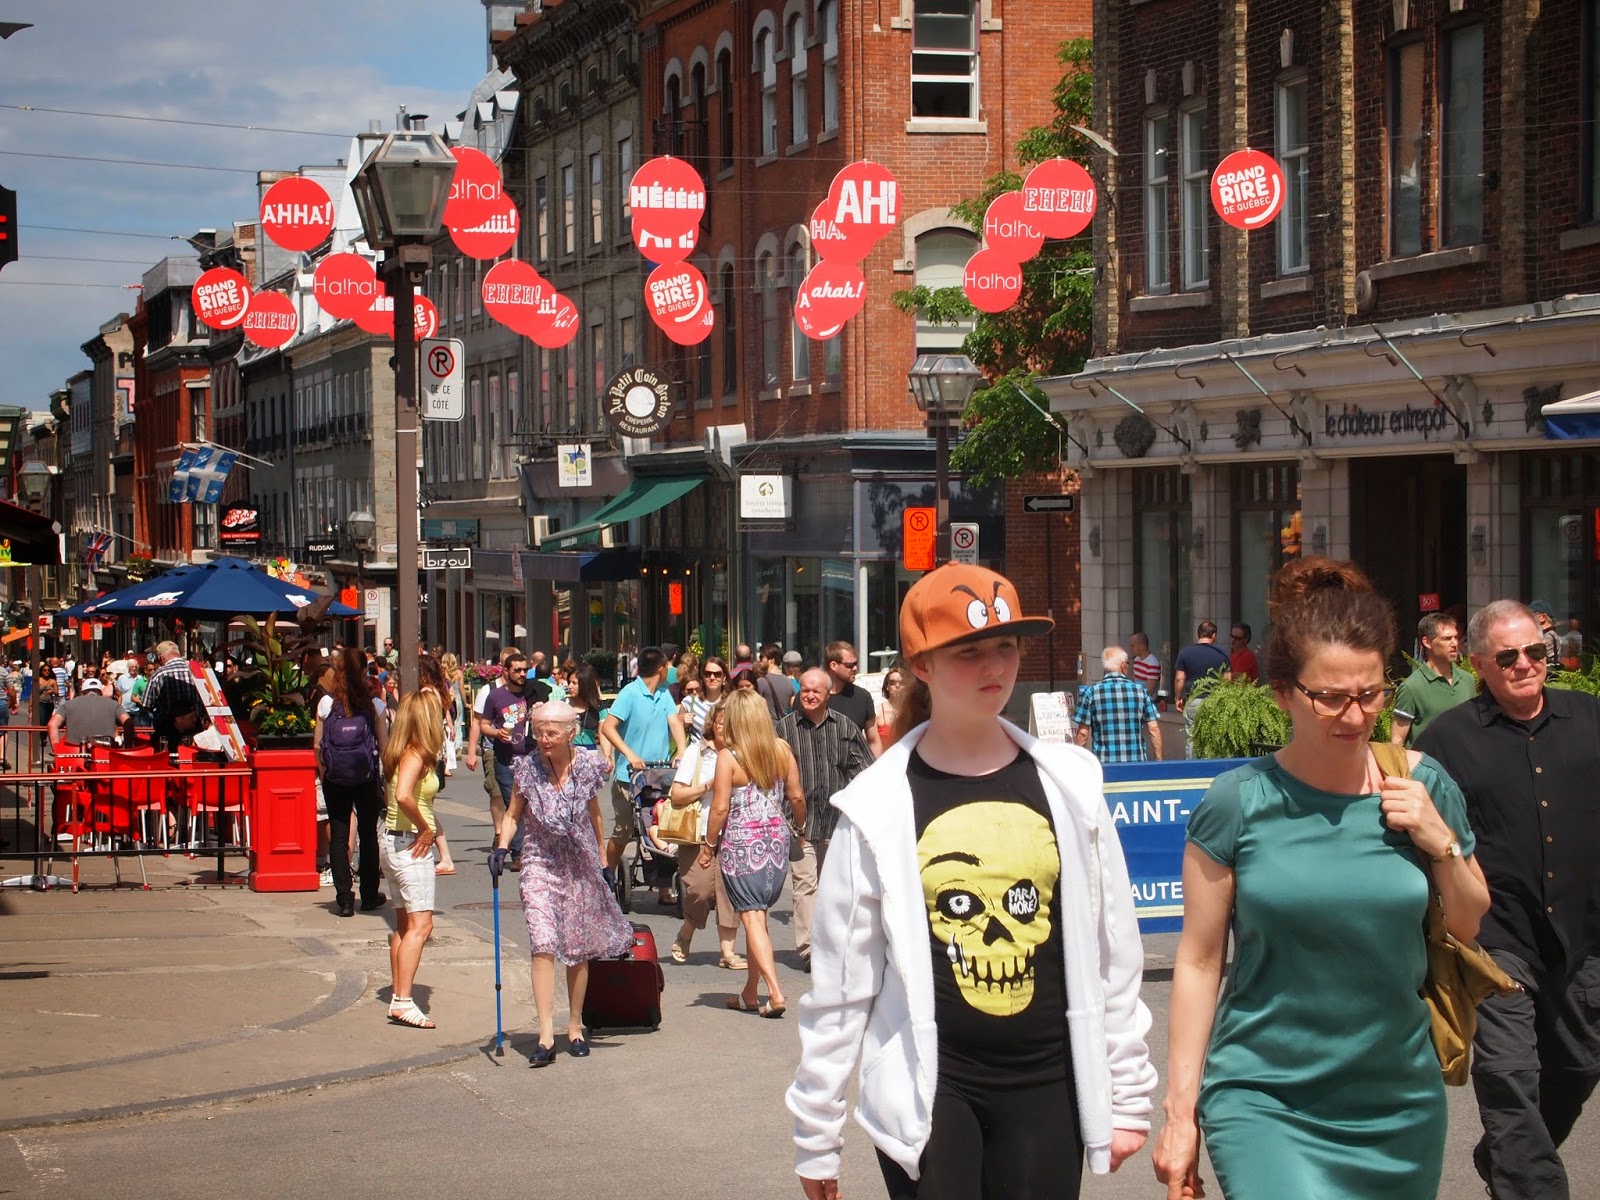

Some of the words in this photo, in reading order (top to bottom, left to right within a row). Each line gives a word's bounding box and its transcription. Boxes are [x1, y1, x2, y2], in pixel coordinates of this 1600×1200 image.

[1216, 165, 1266, 187] GRAND
[1023, 187, 1094, 213] EHEH!
[1220, 176, 1270, 206] RIRE
[835, 179, 897, 225] AH!
[1223, 205, 1236, 215] DE
[1236, 196, 1272, 212] QUÉBEC
[196, 279, 237, 297] GRAND
[313, 276, 378, 296] Ha!ha!
[650, 273, 691, 293] GRAND
[811, 281, 864, 299] ahah!
[964, 271, 1021, 290] Ha!ha!
[199, 288, 241, 312] RIRE
[484, 283, 542, 305] EHEH!
[652, 282, 695, 309] RIRE
[202, 310, 214, 319] DE
[213, 303, 242, 318] QUÉBEC
[656, 306, 667, 316] DE
[667, 297, 697, 312] QUÉBEC
[608, 372, 633, 398] Petit
[634, 368, 658, 387] Coin
[430, 384, 439, 394] DE
[442, 385, 451, 395] CE
[432, 398, 449, 410] CÔTÉ
[609, 398, 626, 415] Au
[653, 383, 672, 419] Breton
[618, 420, 660, 435] RESTAURANT
[1325, 403, 1336, 437] le
[308, 544, 335, 552] RUDSAK
[426, 551, 467, 567] bizou
[1008, 886, 1037, 903] PARA
[1008, 897, 1038, 916] MORE!
